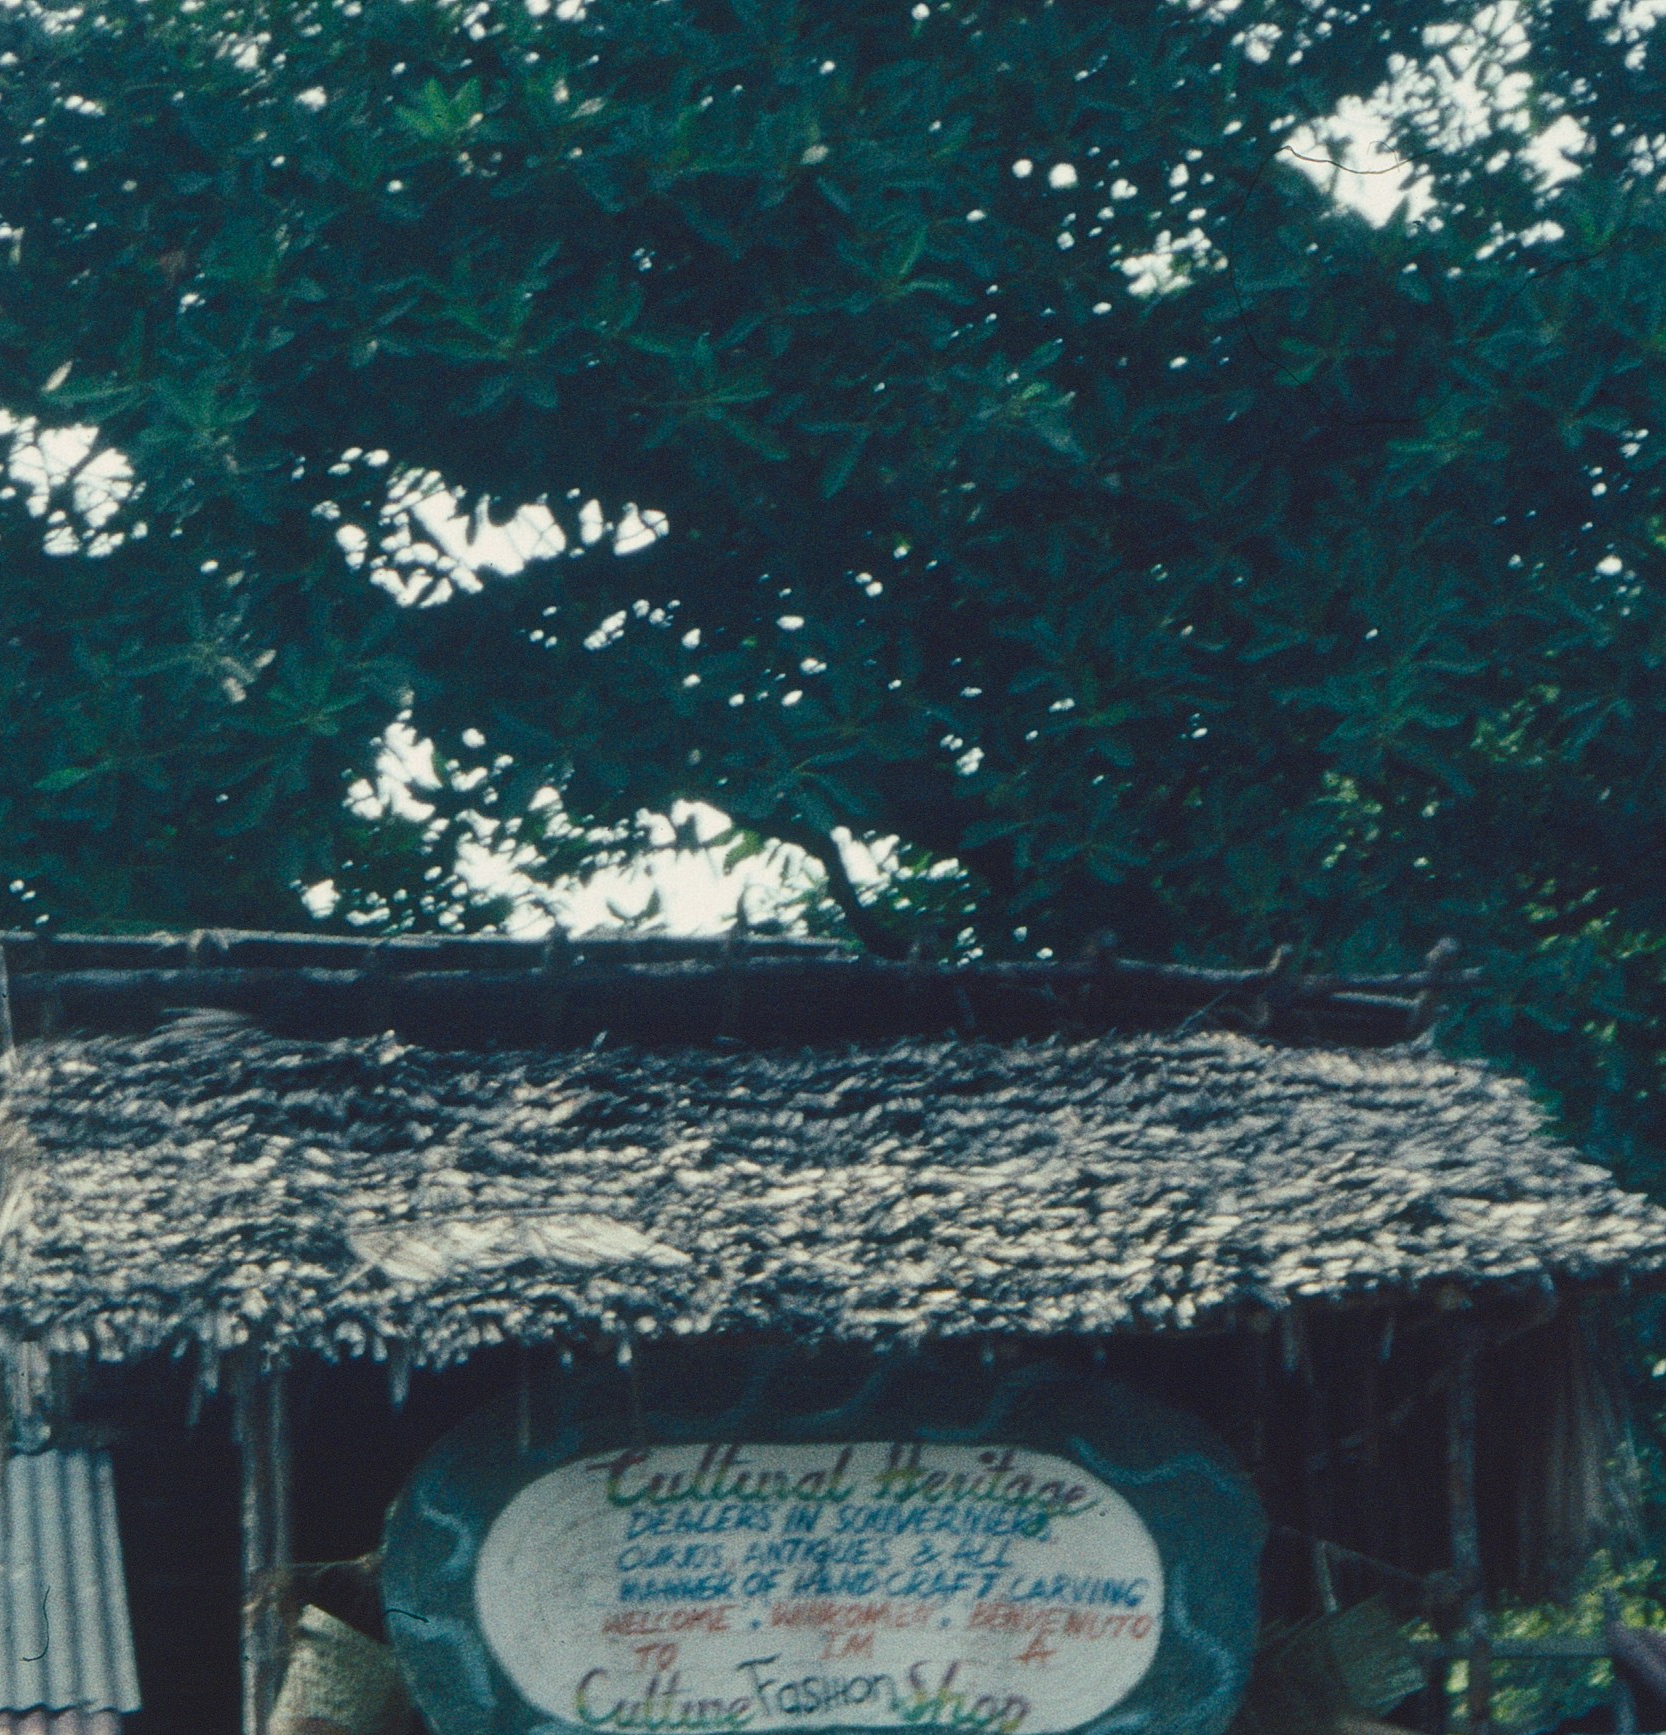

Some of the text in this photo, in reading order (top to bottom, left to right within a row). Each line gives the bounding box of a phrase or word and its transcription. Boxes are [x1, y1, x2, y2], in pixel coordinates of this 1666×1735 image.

[585, 1443, 1099, 1536] Cultural Heritage
[627, 1503, 776, 1540] DEALERS
[782, 1502, 820, 1533] IN
[951, 1539, 1013, 1569] ALL
[743, 1567, 786, 1597] OF
[1007, 1571, 1152, 1608] CARVING
[633, 1641, 677, 1671] TO
